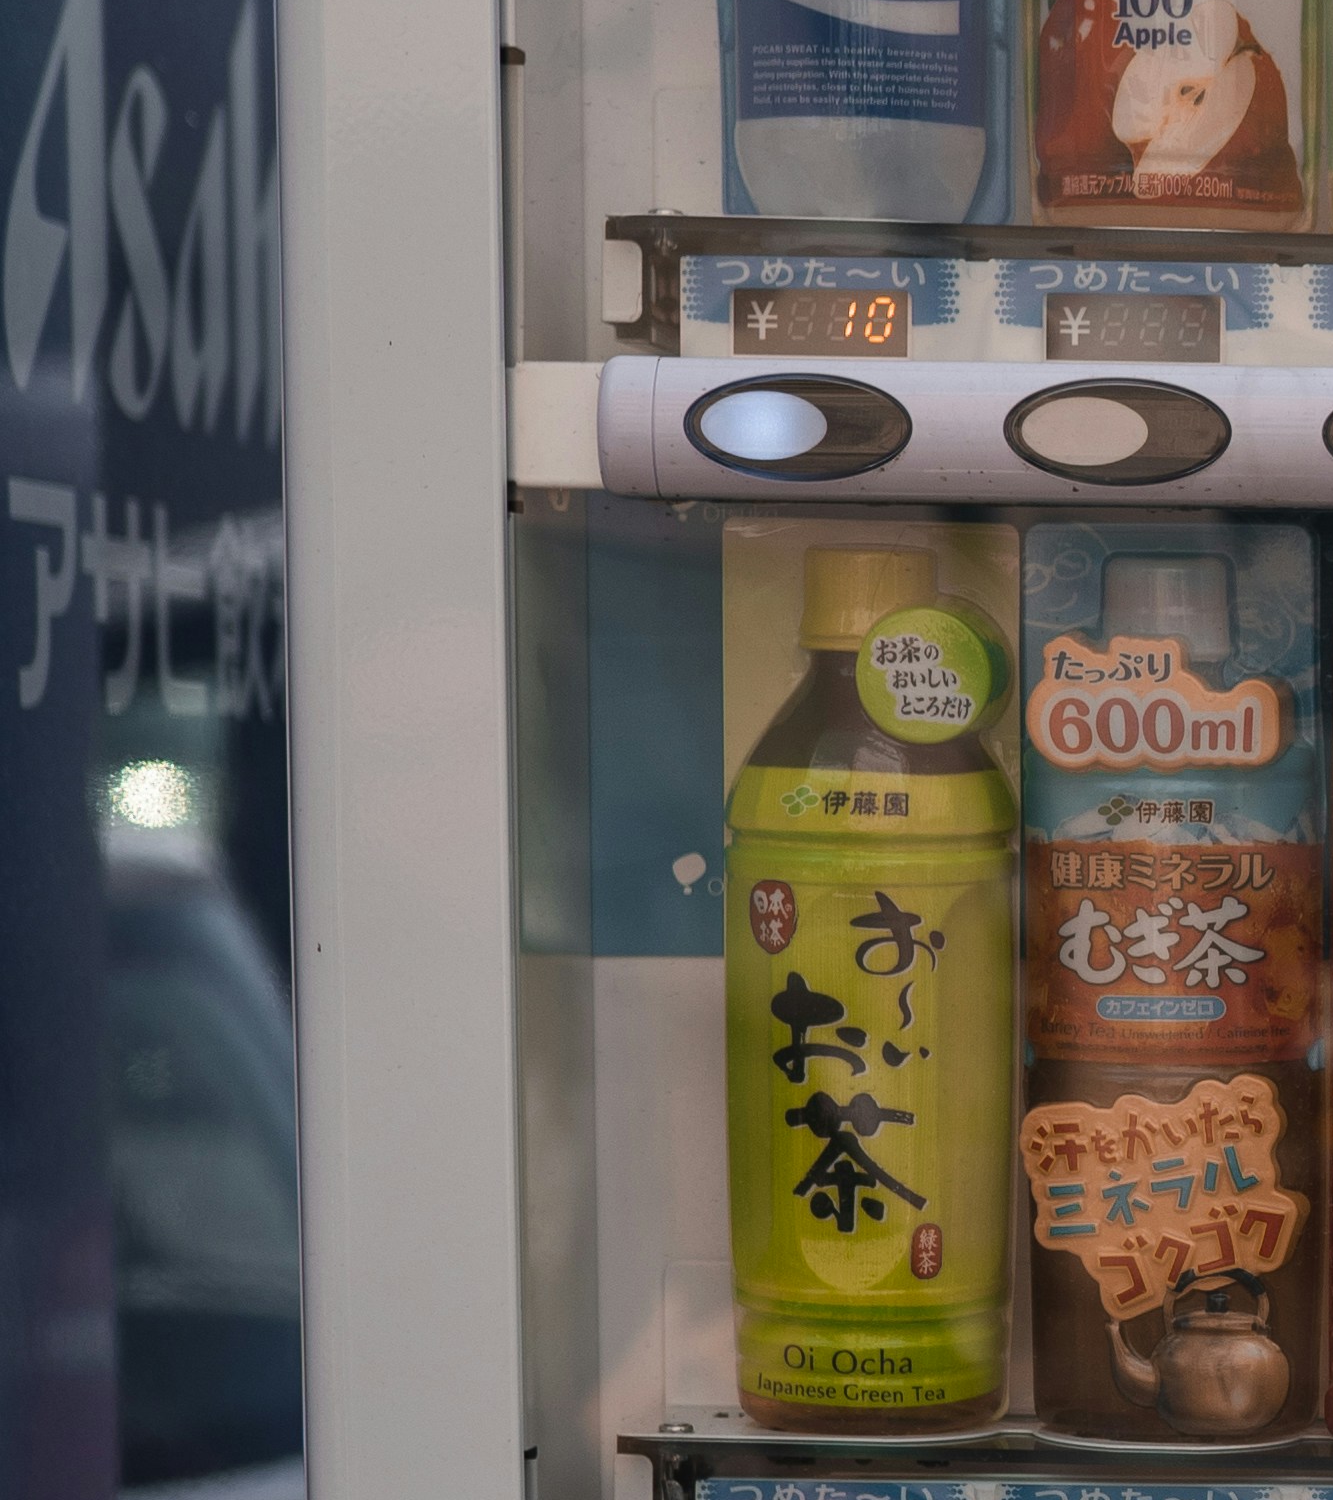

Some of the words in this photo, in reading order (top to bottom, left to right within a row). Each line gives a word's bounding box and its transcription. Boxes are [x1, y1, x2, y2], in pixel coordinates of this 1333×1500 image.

[1114, 23, 1192, 49] Apple
[876, 638, 938, 664] お茶の
[1052, 651, 1171, 683] たっぷり
[892, 669, 957, 689] おいしい
[901, 696, 972, 719] ところだけ
[1049, 698, 1253, 755] 600ml
[1051, 852, 1273, 890] 健康ミネラル
[1059, 895, 1264, 988] むぎ茶
[1105, 1000, 1213, 1015] カフェインゼロ
[770, 970, 928, 1233] お茶
[1031, 1097, 1263, 1173] 汗をかいたら
[1048, 1146, 1258, 1237] ミネラル
[783, 1343, 815, 1376] Oi
[832, 1349, 914, 1377] Ocha
[757, 1376, 836, 1405] Japanese
[842, 1384, 904, 1405] Green
[910, 1385, 947, 1404] Tea
